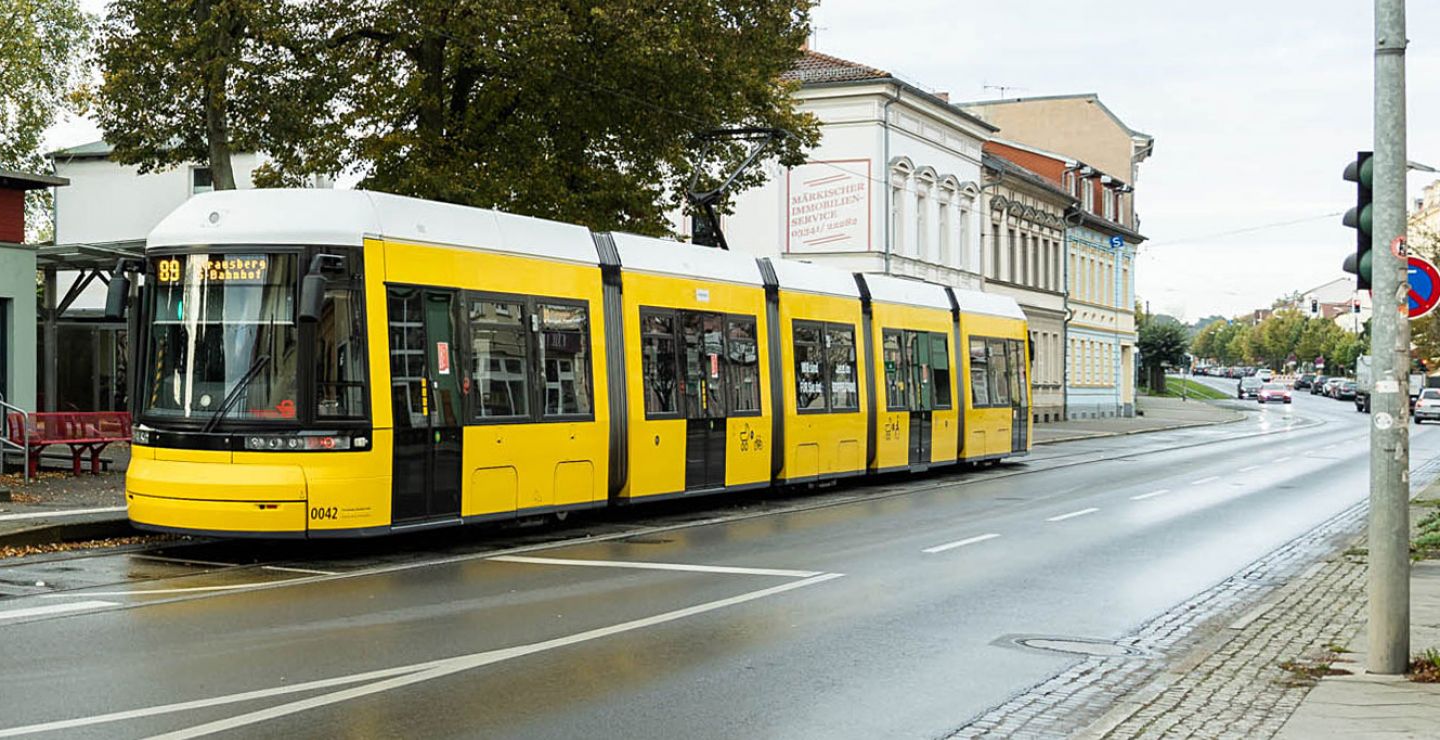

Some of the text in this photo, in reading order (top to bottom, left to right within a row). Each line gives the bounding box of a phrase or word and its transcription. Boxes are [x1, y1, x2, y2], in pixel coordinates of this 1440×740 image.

[792, 183, 865, 205] MÄRKISCHER
[791, 210, 837, 227] SERVICE
[311, 507, 338, 520] 0042
